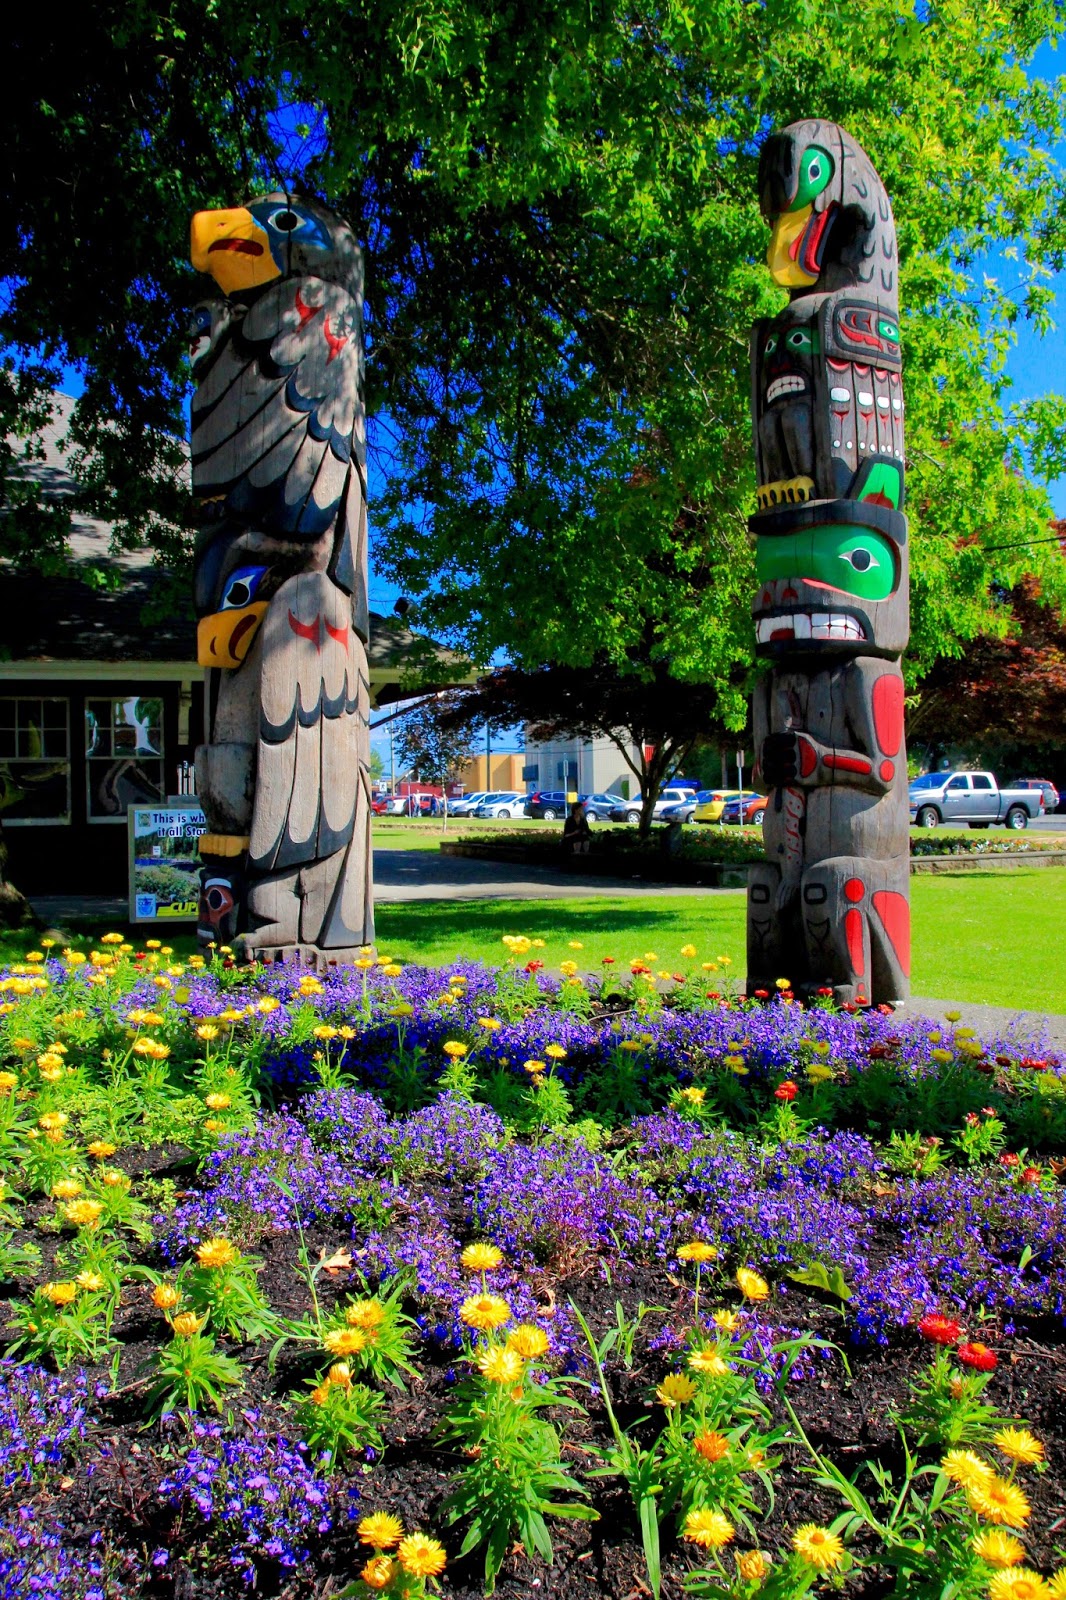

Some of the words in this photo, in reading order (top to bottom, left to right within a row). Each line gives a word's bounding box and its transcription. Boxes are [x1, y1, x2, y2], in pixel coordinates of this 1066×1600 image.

[153, 813, 174, 823] This
[177, 813, 187, 823] is
[158, 826, 165, 836] it
[169, 826, 182, 836] all
